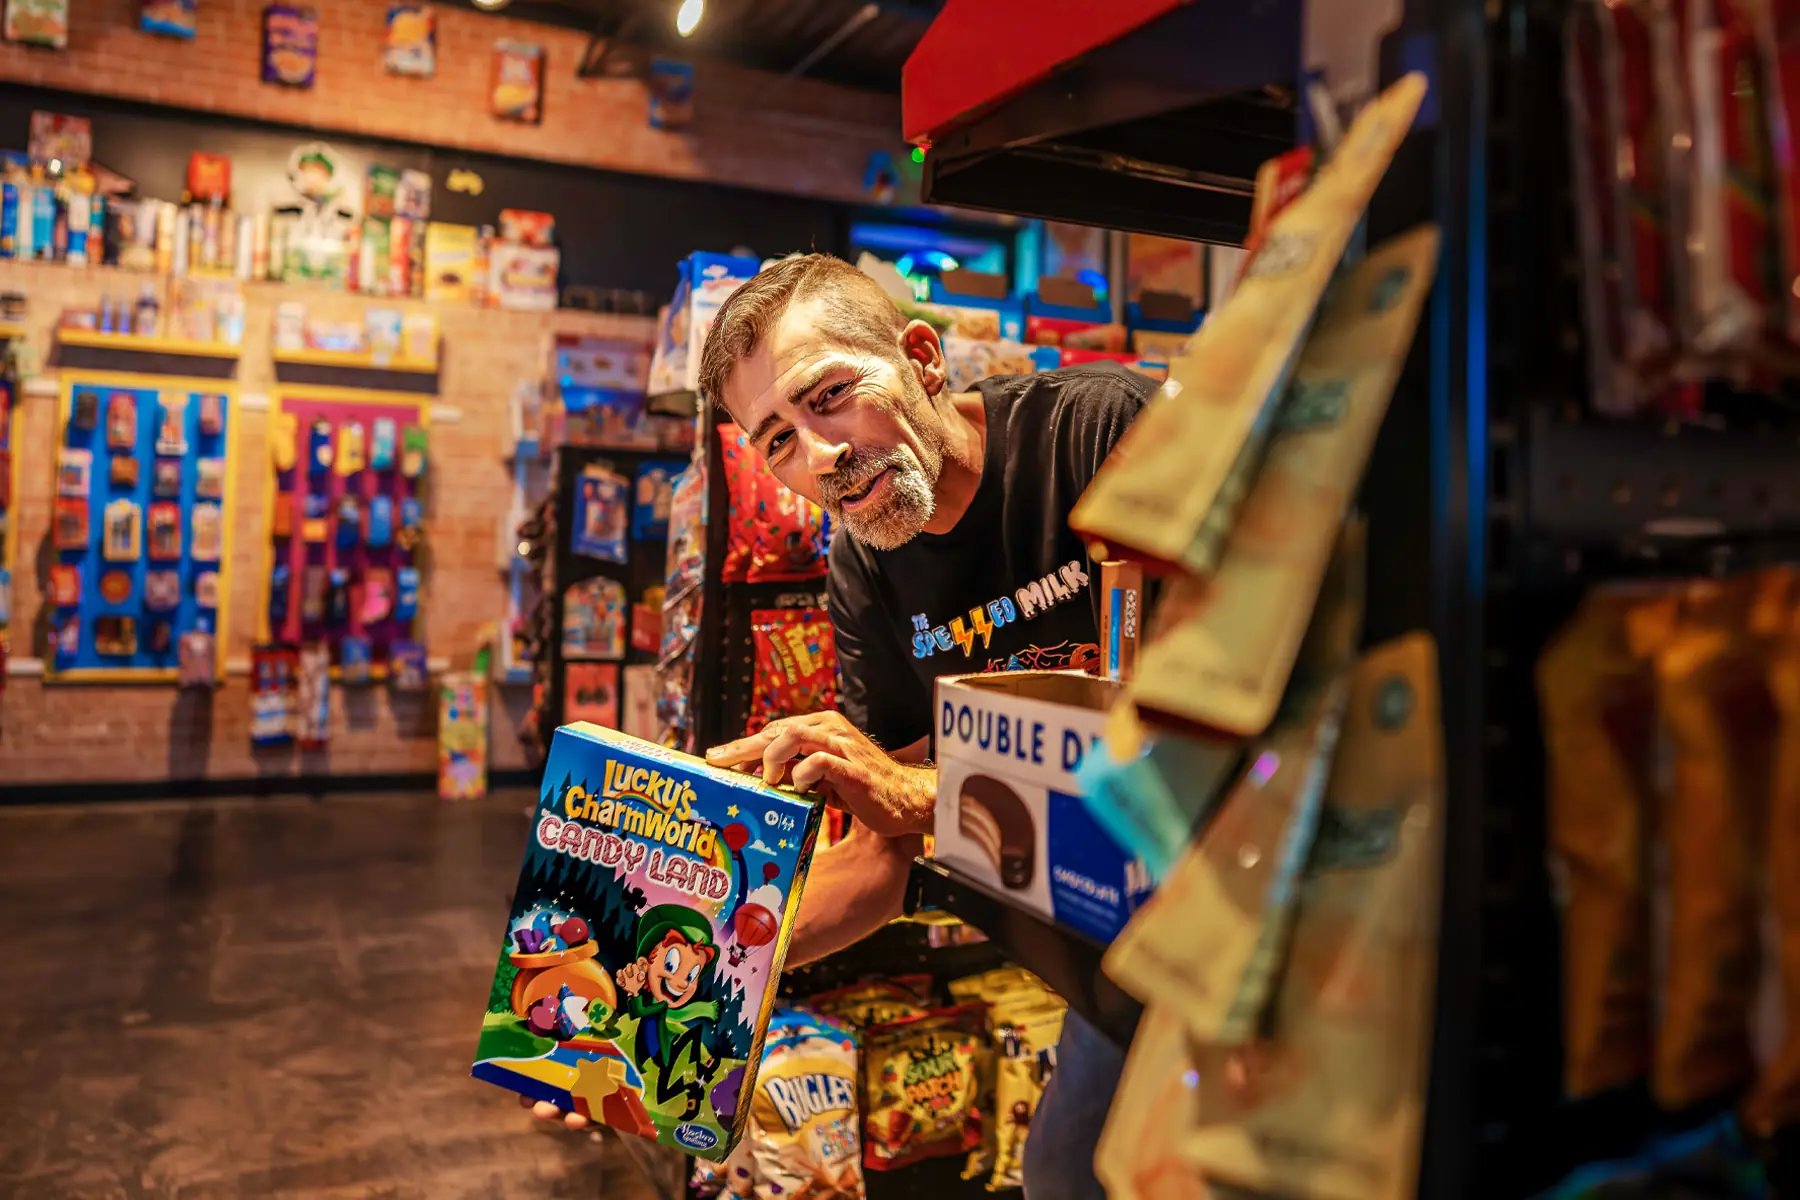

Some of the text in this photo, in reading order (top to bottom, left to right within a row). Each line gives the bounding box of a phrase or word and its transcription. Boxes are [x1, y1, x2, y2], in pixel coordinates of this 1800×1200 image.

[1014, 560, 1089, 620] MILK
[942, 701, 1046, 764] DOUBLE
[564, 785, 717, 860] CharmWorld
[537, 816, 731, 901] CANDY LAND
